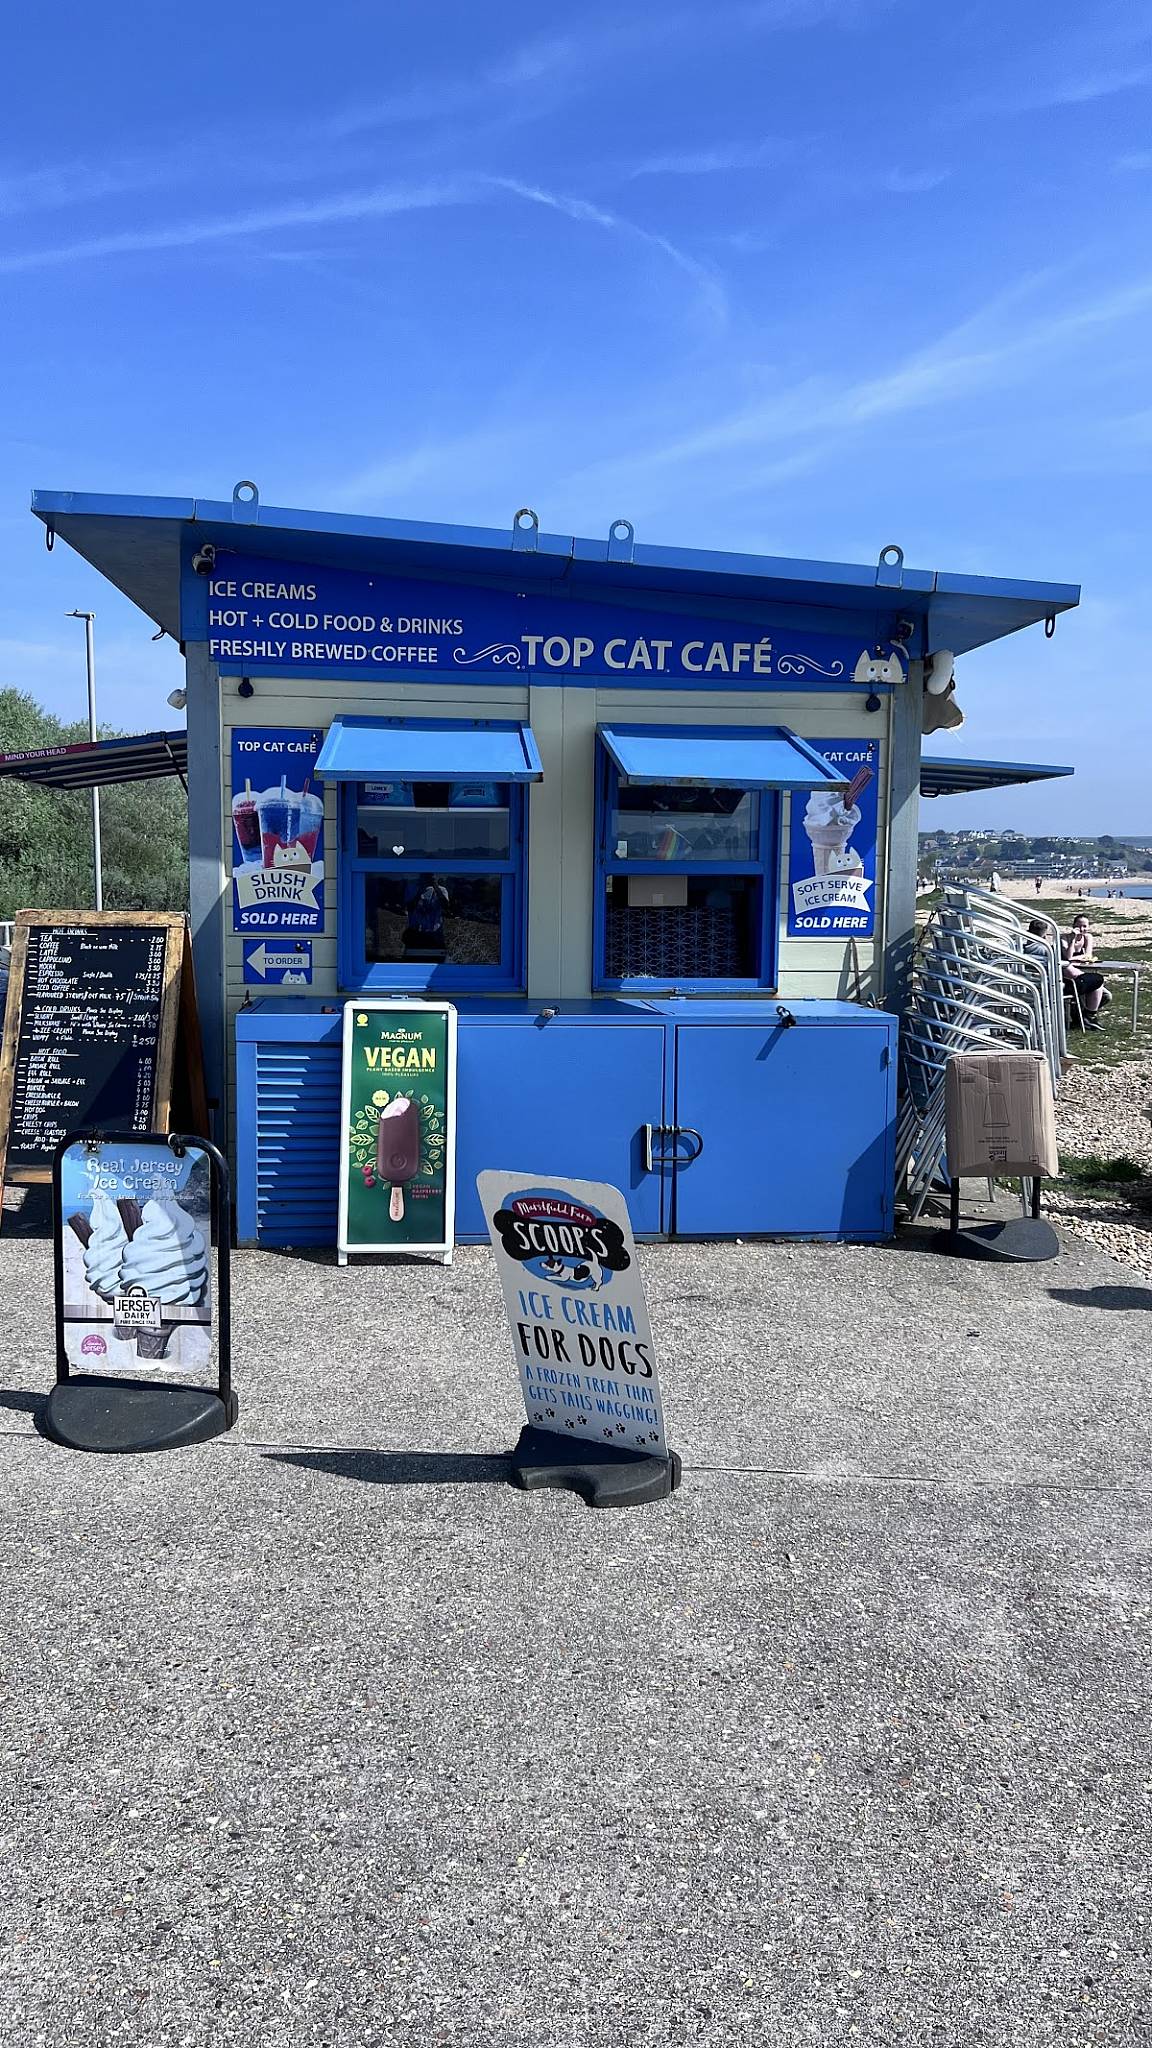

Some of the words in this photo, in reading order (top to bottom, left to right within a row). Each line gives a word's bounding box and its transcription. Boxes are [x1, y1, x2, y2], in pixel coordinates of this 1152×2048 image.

[209, 580, 236, 597] ICE
[241, 582, 317, 601] CREAMS
[209, 611, 248, 627] HOT
[268, 612, 319, 630] COLD
[323, 615, 376, 632] FOOD
[380, 617, 394, 633] &
[398, 617, 463, 635] DRINKS
[209, 639, 287, 658] FRESHLY
[292, 642, 367, 661] BREWED
[371, 646, 438, 663] COFFEE
[521, 635, 595, 667] TOP
[604, 638, 672, 670] CAT
[681, 637, 772, 673] CAFÉ
[5, 752, 25, 761] MIND
[25, 751, 45, 759] YOUR
[47, 748, 67, 756] HEAD
[238, 741, 260, 751] TOP
[263, 742, 285, 752] CAT
[287, 741, 316, 753] CAFÉ
[823, 752, 844, 762] CAT
[845, 751, 873, 762] CAFÉ
[251, 873, 307, 887] SLUSH
[797, 881, 826, 896] SOFT
[828, 880, 862, 892] SERVE
[255, 886, 303, 900] DRINK
[805, 894, 820, 906] ICE
[822, 893, 856, 904] CREAM
[241, 912, 278, 924] SOLD
[281, 913, 318, 925] HERE
[795, 917, 831, 929] SOLD
[833, 917, 868, 928] HERE
[381, 1031, 423, 1040] MAGNUM
[364, 1047, 436, 1068] VEGAN
[87, 1157, 125, 1173] Real
[130, 1159, 183, 1176] Jersey
[93, 1174, 118, 1190] Ice
[123, 1175, 178, 1190] Cream
[516, 1201, 570, 1216] Marshfield
[569, 1205, 593, 1223] Farm
[513, 1221, 608, 1258] SCOOP'S
[116, 1299, 158, 1312] JERSEY
[518, 1290, 554, 1320] ICE
[561, 1296, 637, 1335] CREAM
[517, 1322, 571, 1363] FOR
[578, 1333, 653, 1378] DOGS
[525, 1364, 533, 1380] A
[537, 1366, 580, 1388] FROZEN
[584, 1376, 620, 1397] TREAT
[626, 1383, 654, 1404] THAT
[529, 1385, 557, 1403] GETS
[560, 1390, 593, 1411] TAILS
[596, 1398, 658, 1426] WAGGING!
